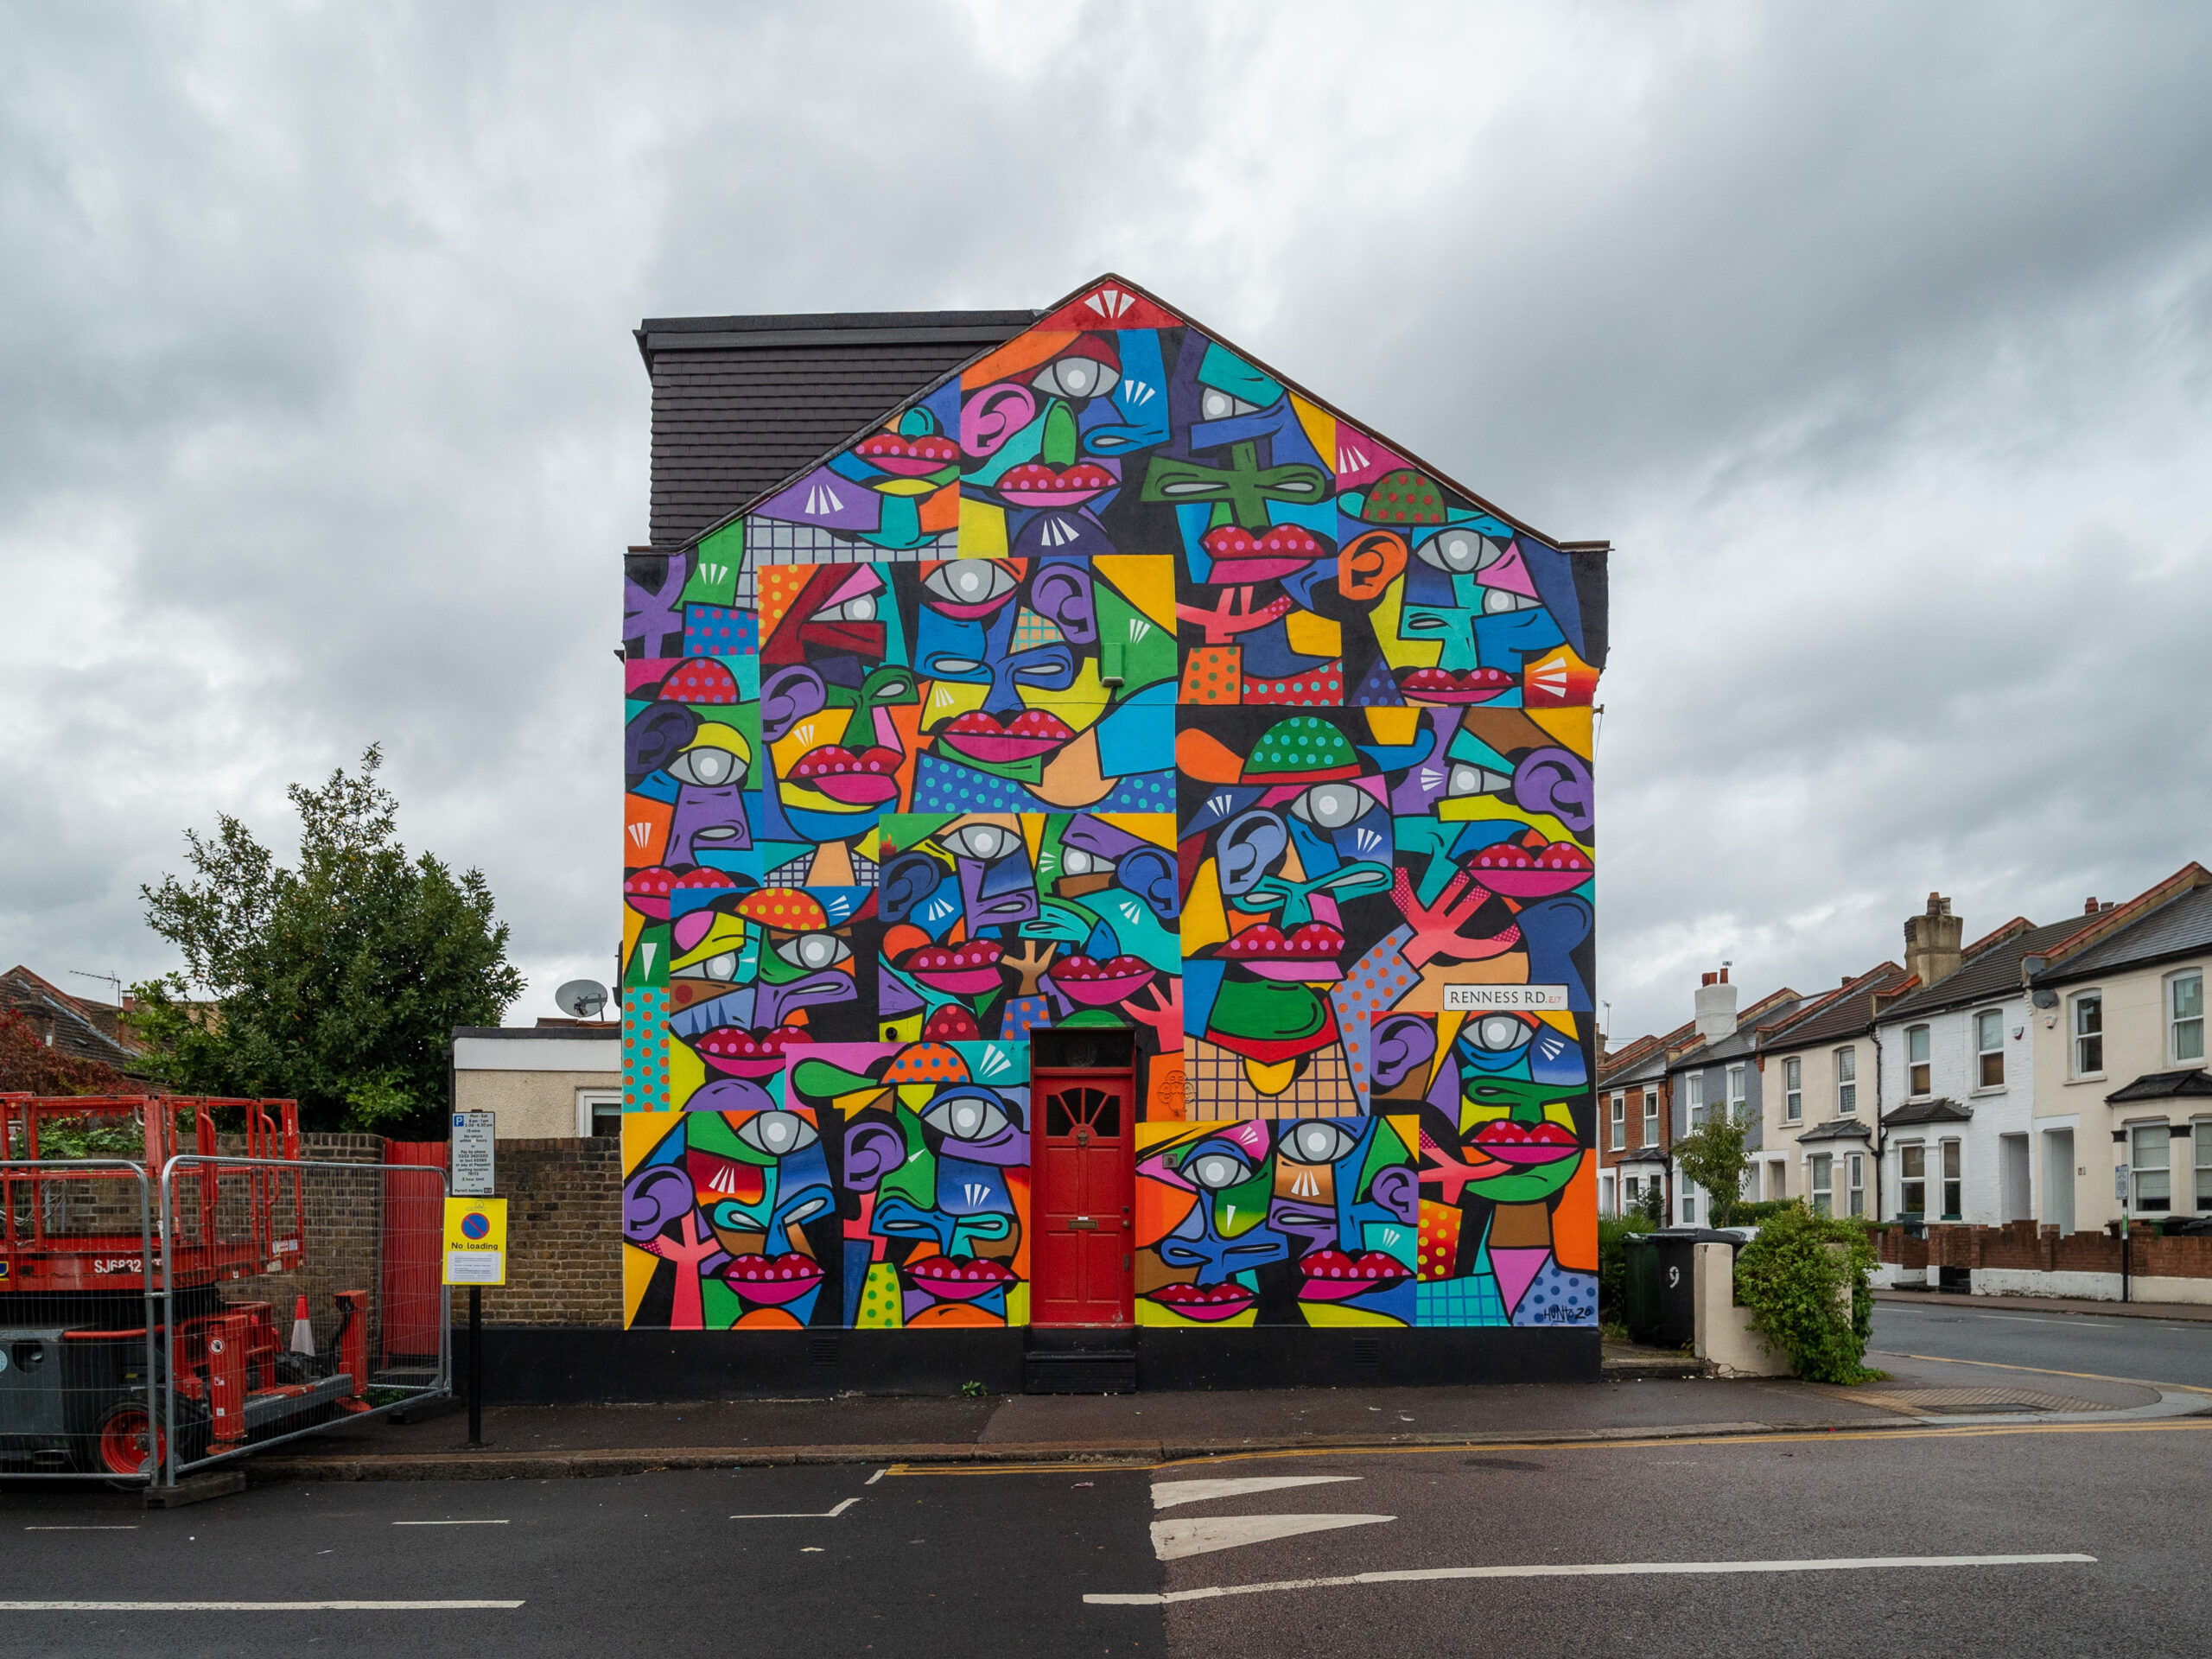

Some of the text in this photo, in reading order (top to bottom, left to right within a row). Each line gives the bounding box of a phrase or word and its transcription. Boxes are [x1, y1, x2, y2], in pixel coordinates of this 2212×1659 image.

[1451, 991, 1519, 1003] RENNESS
[456, 1116, 463, 1126] P
[1669, 1266, 1680, 1288] 9
[1575, 1306, 1592, 1319] 20
